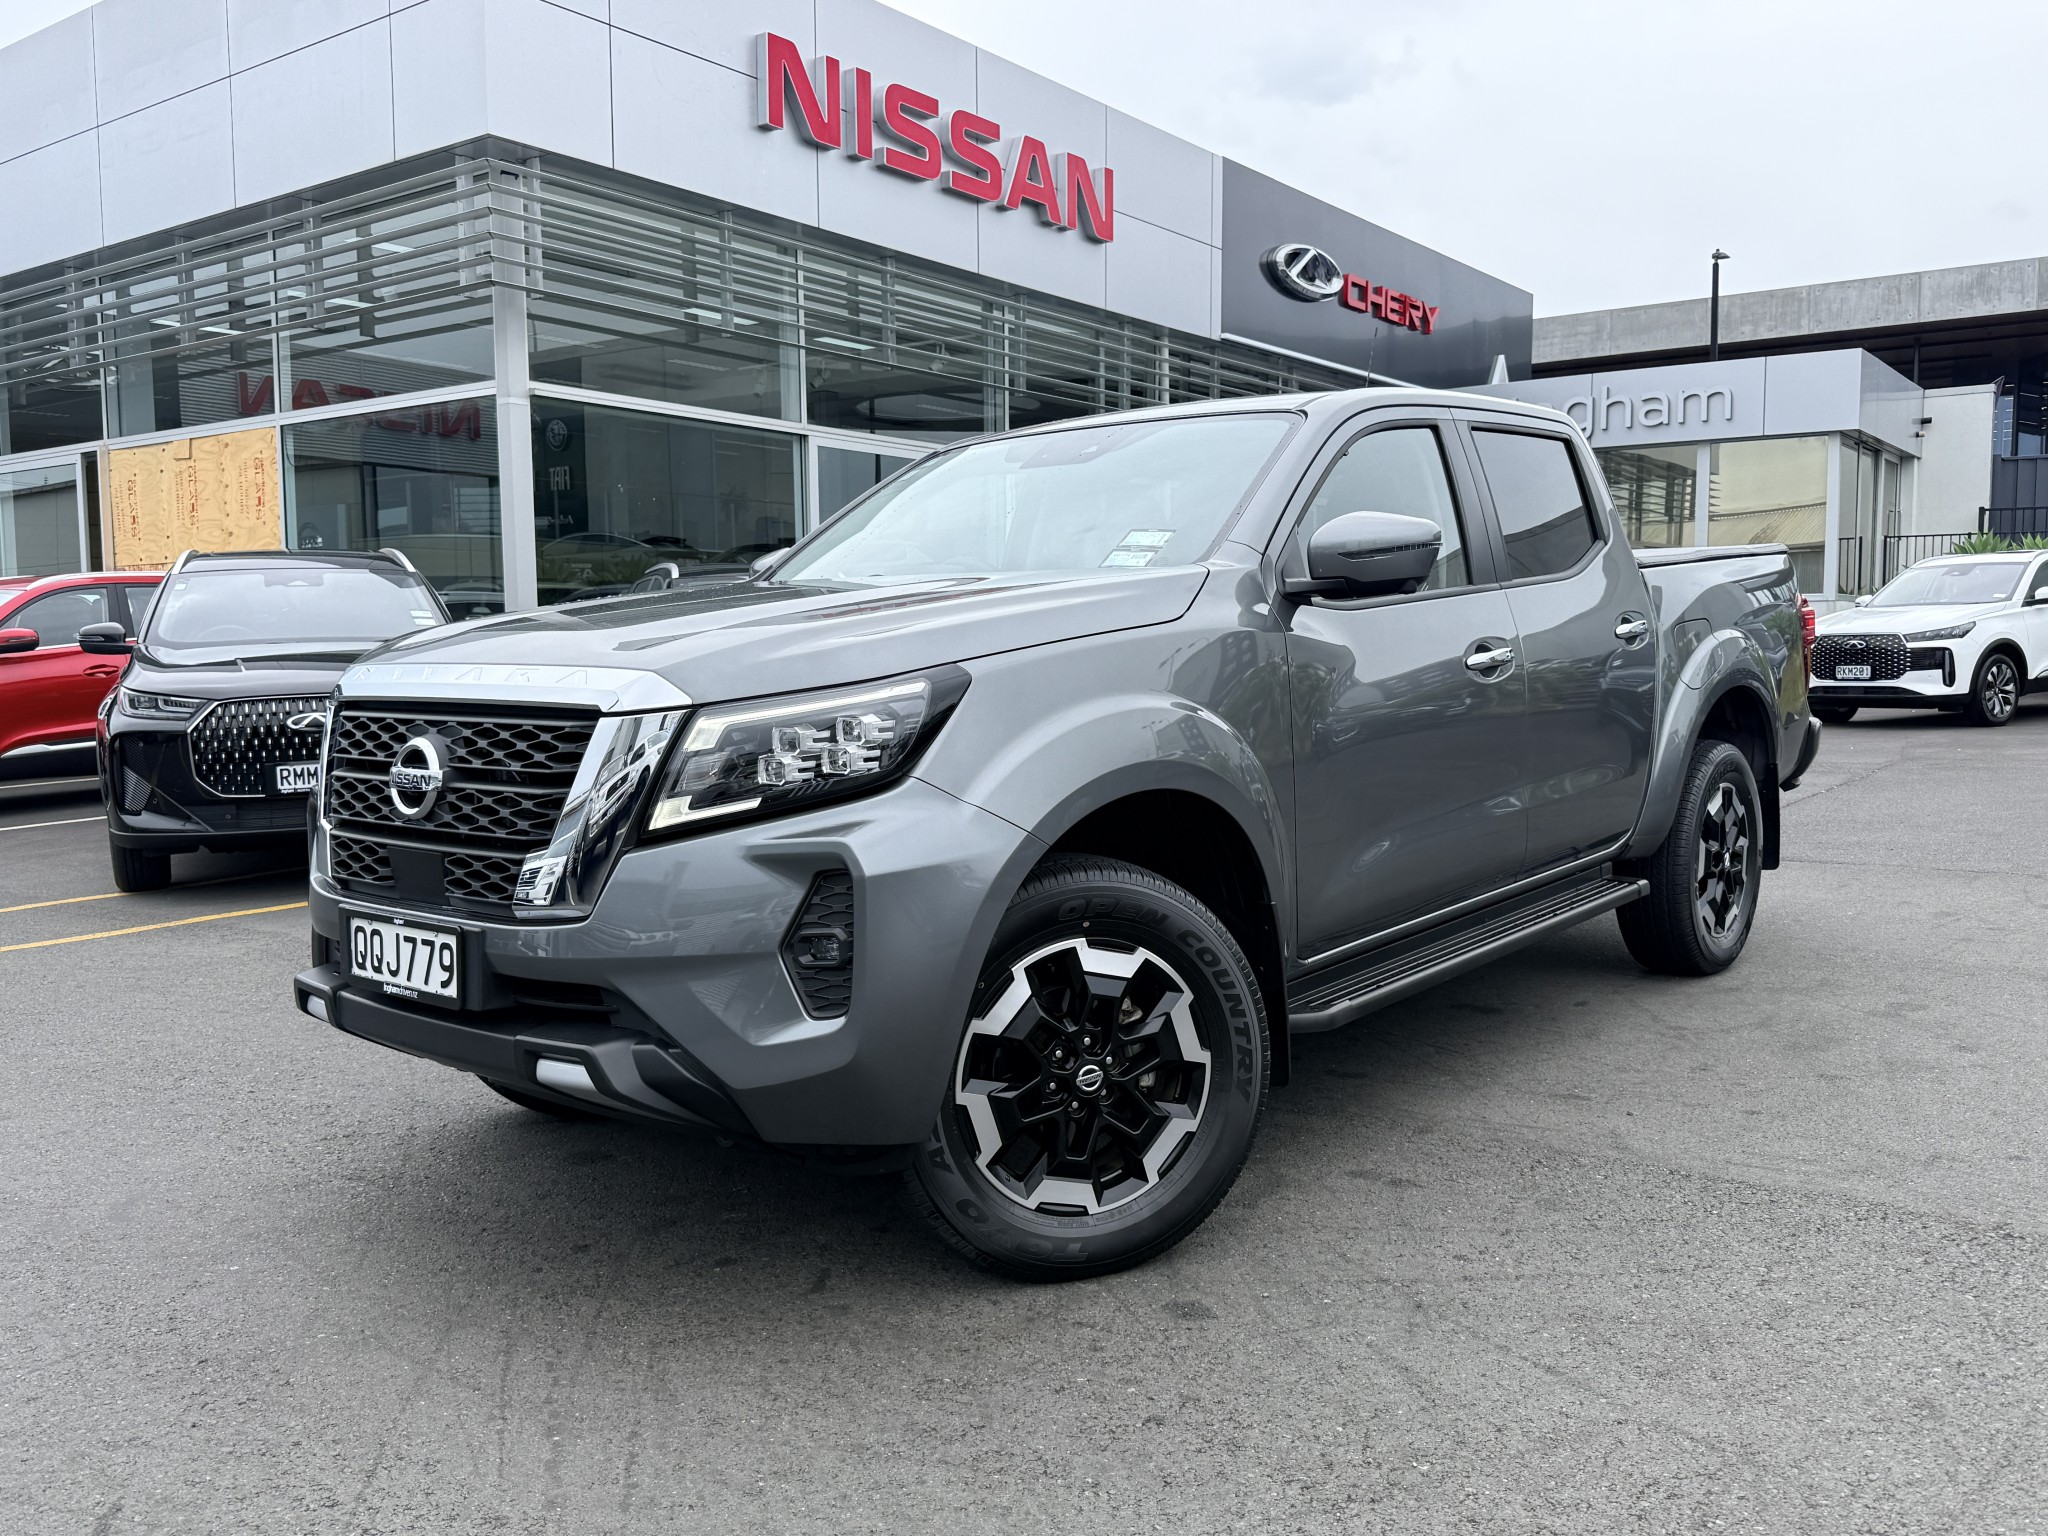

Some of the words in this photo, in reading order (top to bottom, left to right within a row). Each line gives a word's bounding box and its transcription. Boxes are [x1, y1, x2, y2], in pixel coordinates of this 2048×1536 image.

[756, 31, 1114, 243] NISSAN
[1342, 273, 1440, 334] CHERY
[1550, 385, 1733, 440] gham
[354, 925, 455, 989] QQJ779
[1058, 898, 1170, 927] OPEN
[1176, 928, 1254, 1104] COUNTRY
